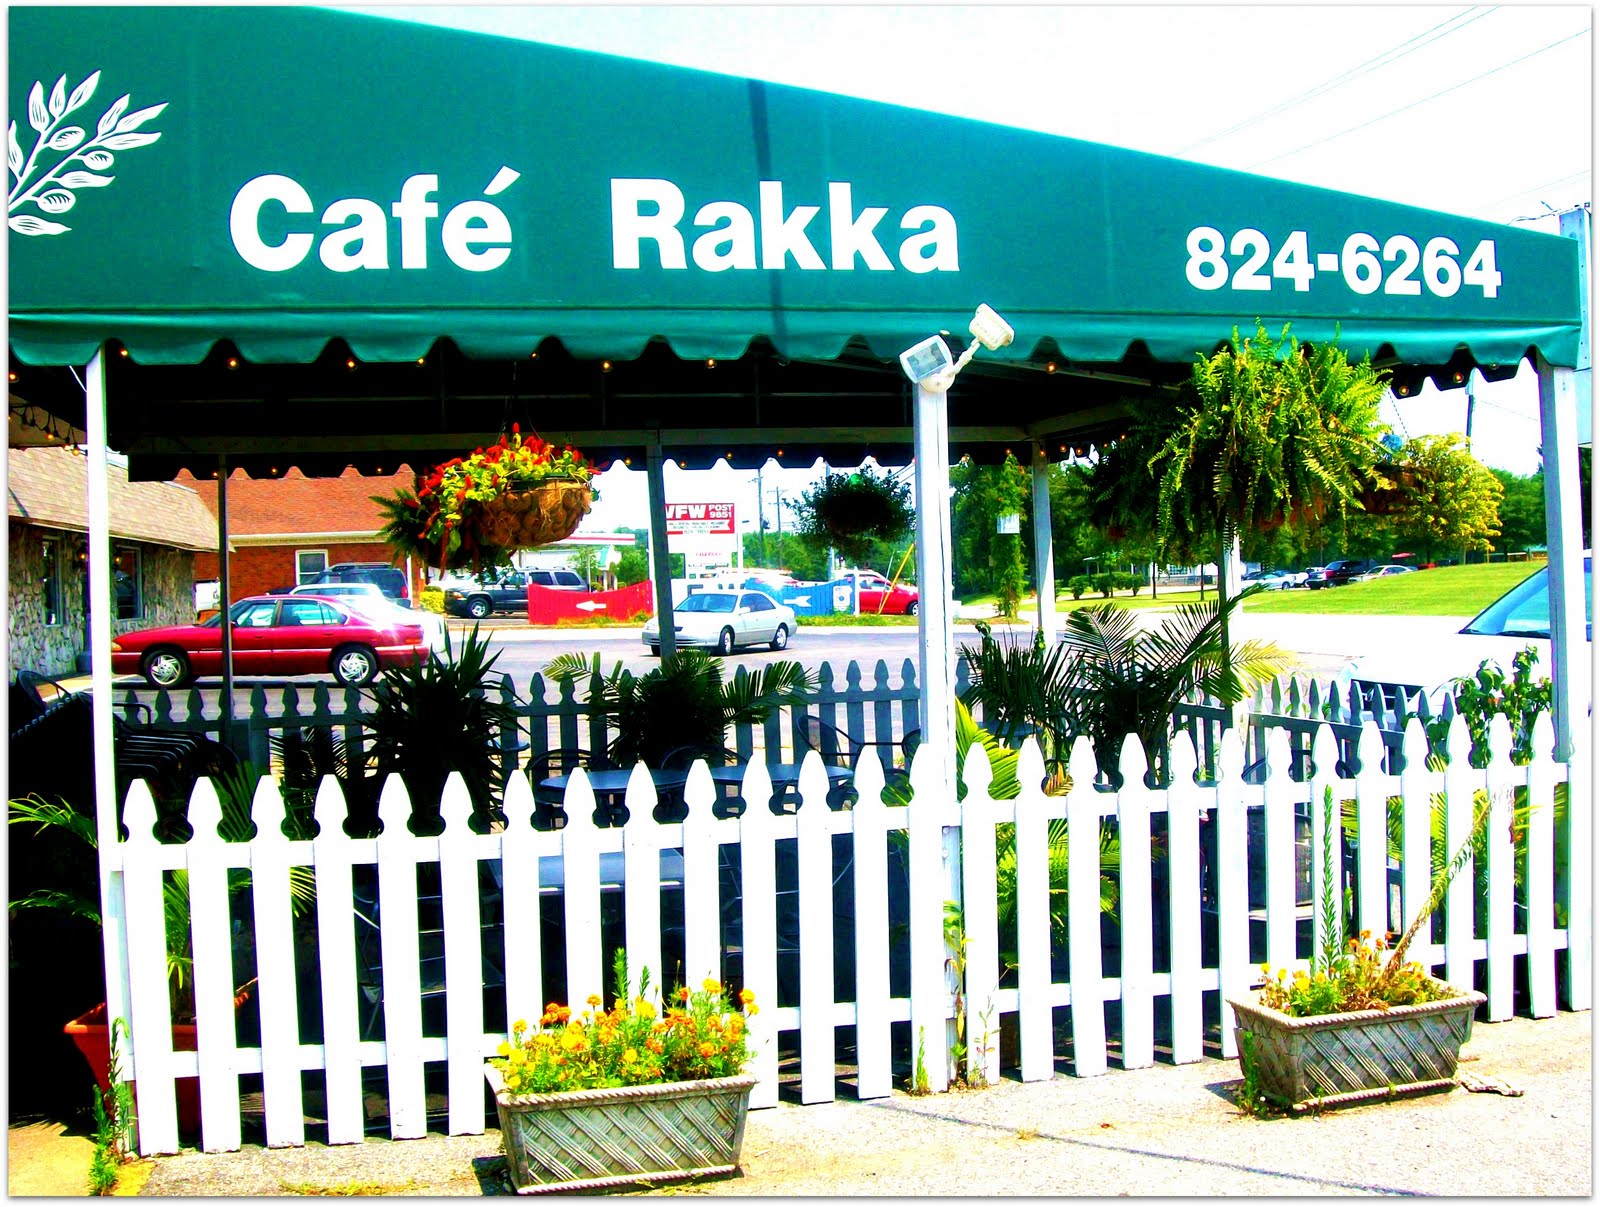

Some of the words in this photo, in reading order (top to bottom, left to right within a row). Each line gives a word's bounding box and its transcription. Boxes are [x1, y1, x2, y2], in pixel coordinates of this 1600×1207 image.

[229, 165, 521, 272] Café
[610, 178, 960, 274] Rakka
[1185, 226, 1502, 298] 824-6264
[665, 504, 707, 519] VFW
